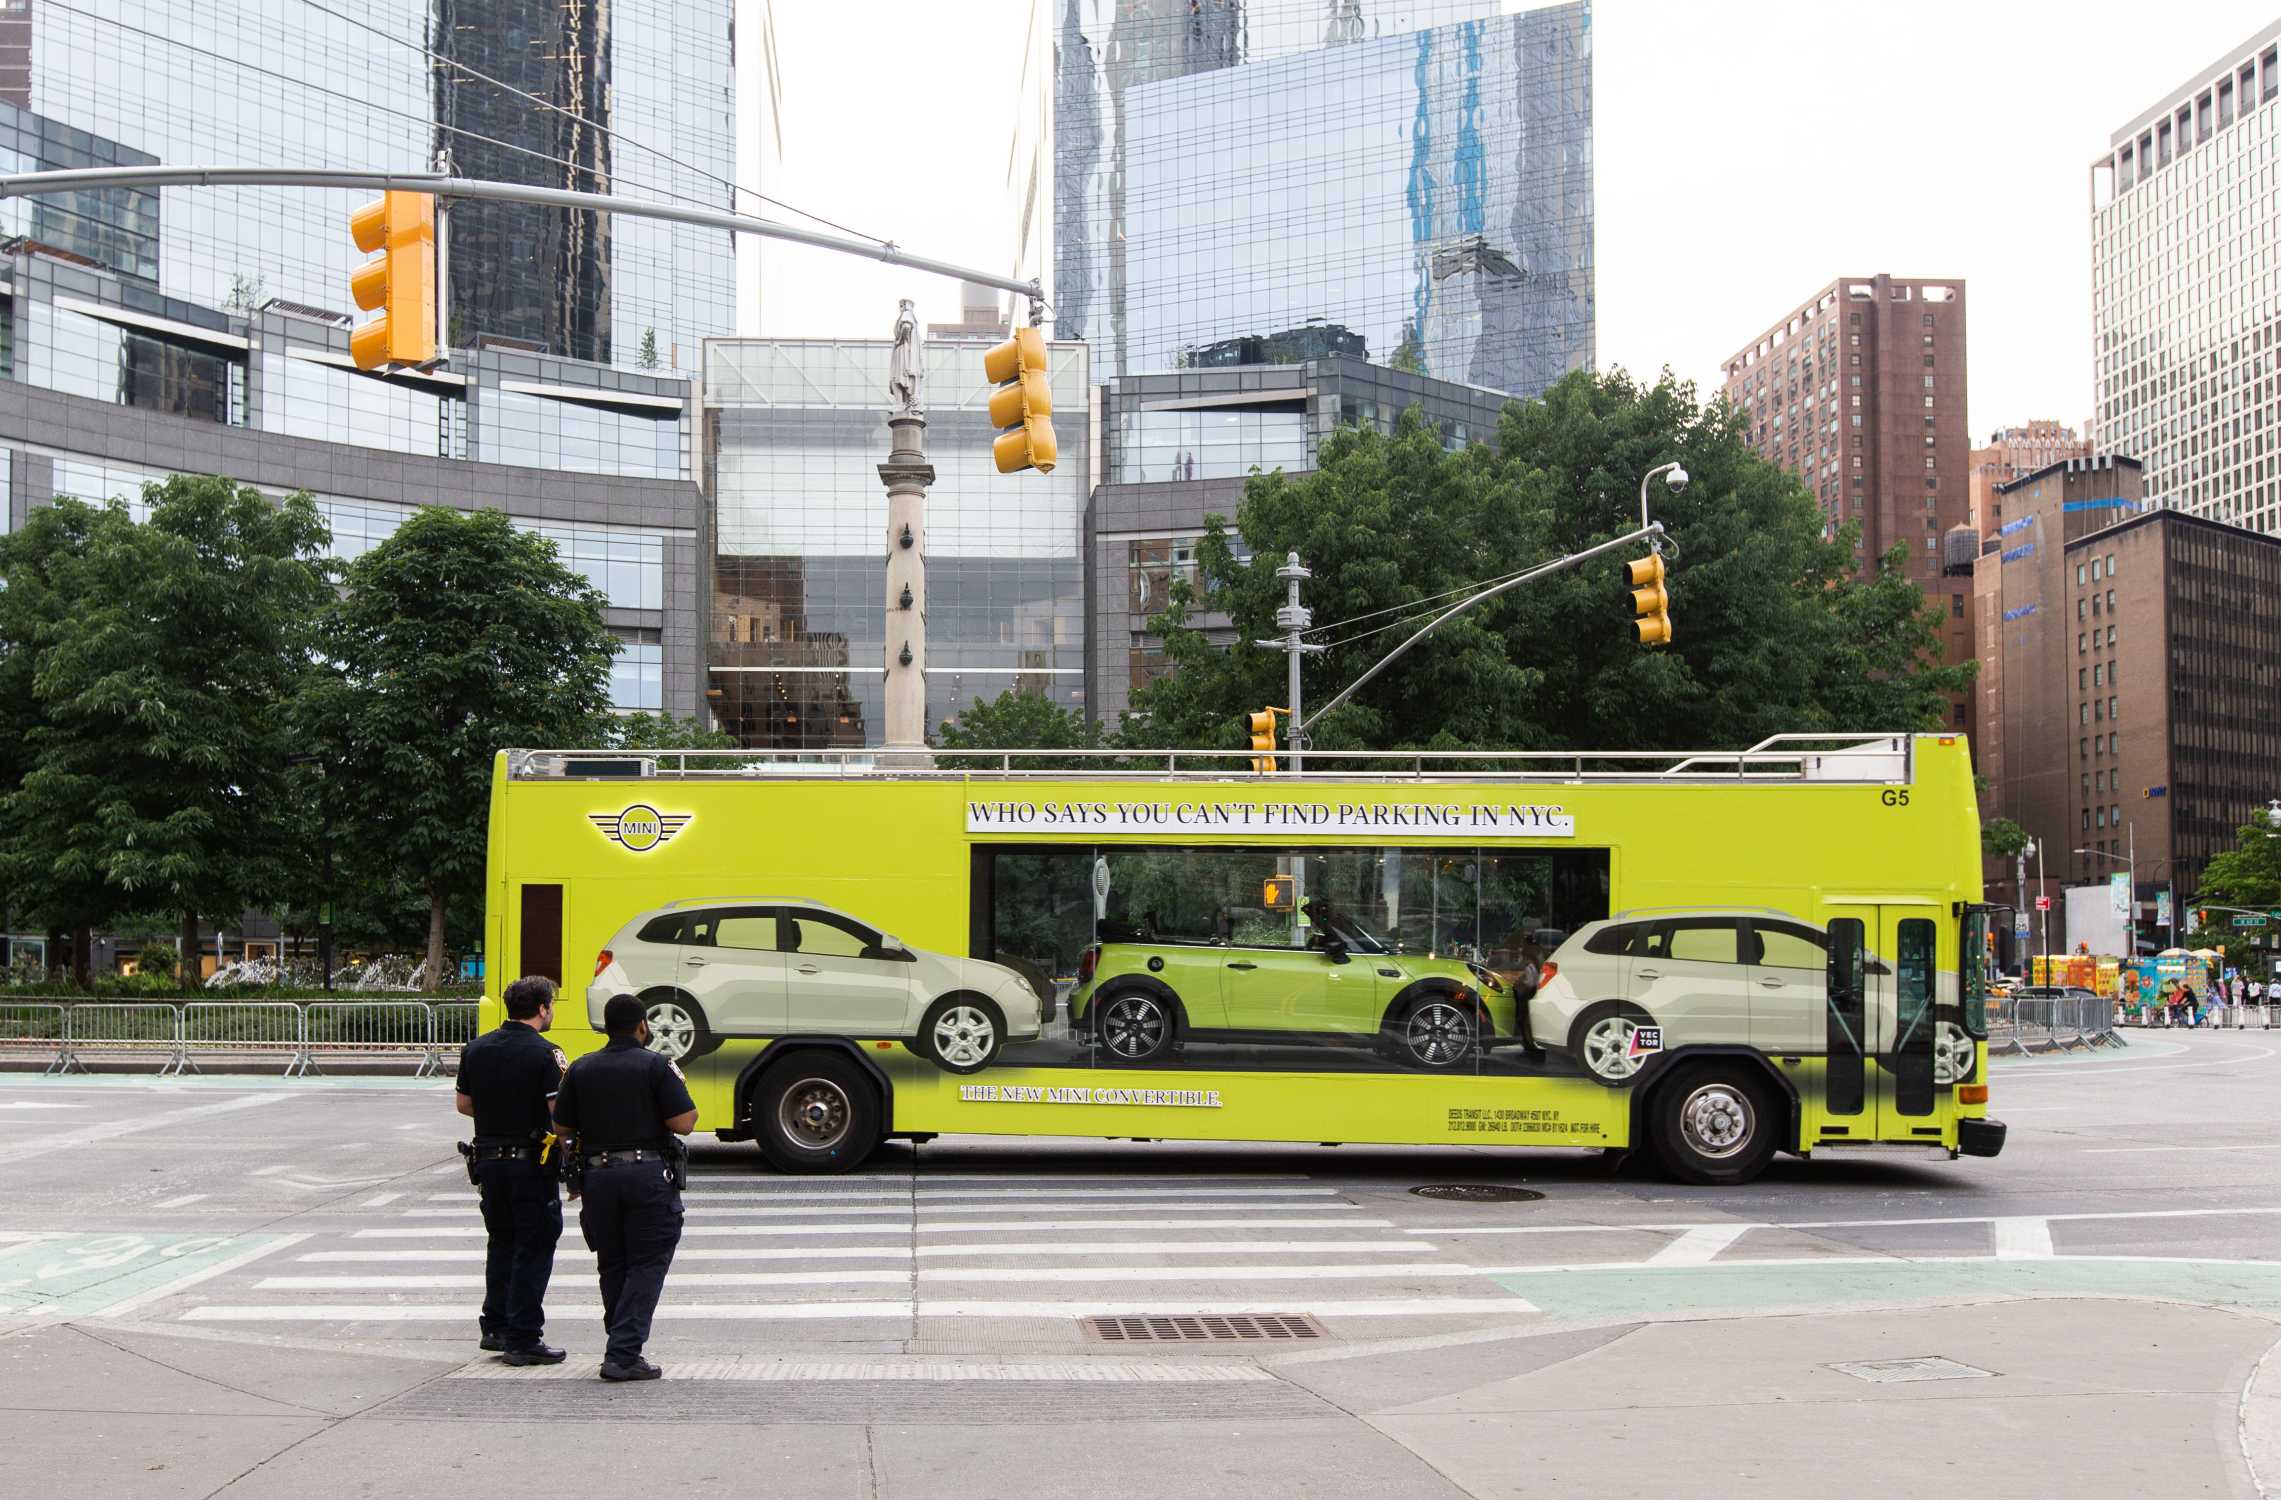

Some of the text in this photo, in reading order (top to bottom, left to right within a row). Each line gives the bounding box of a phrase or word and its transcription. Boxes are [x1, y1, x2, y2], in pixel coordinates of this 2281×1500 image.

[1881, 789, 1910, 807] G5
[969, 802, 1570, 827] WHO SAYS YOU CAN'T FIND PARKING IN NYC.
[623, 822, 657, 835] MINI
[1640, 1031, 1658, 1039] VEC
[960, 1085, 997, 1100] THE
[1001, 1086, 1043, 1101] NEW
[1047, 1087, 1090, 1103] MINI
